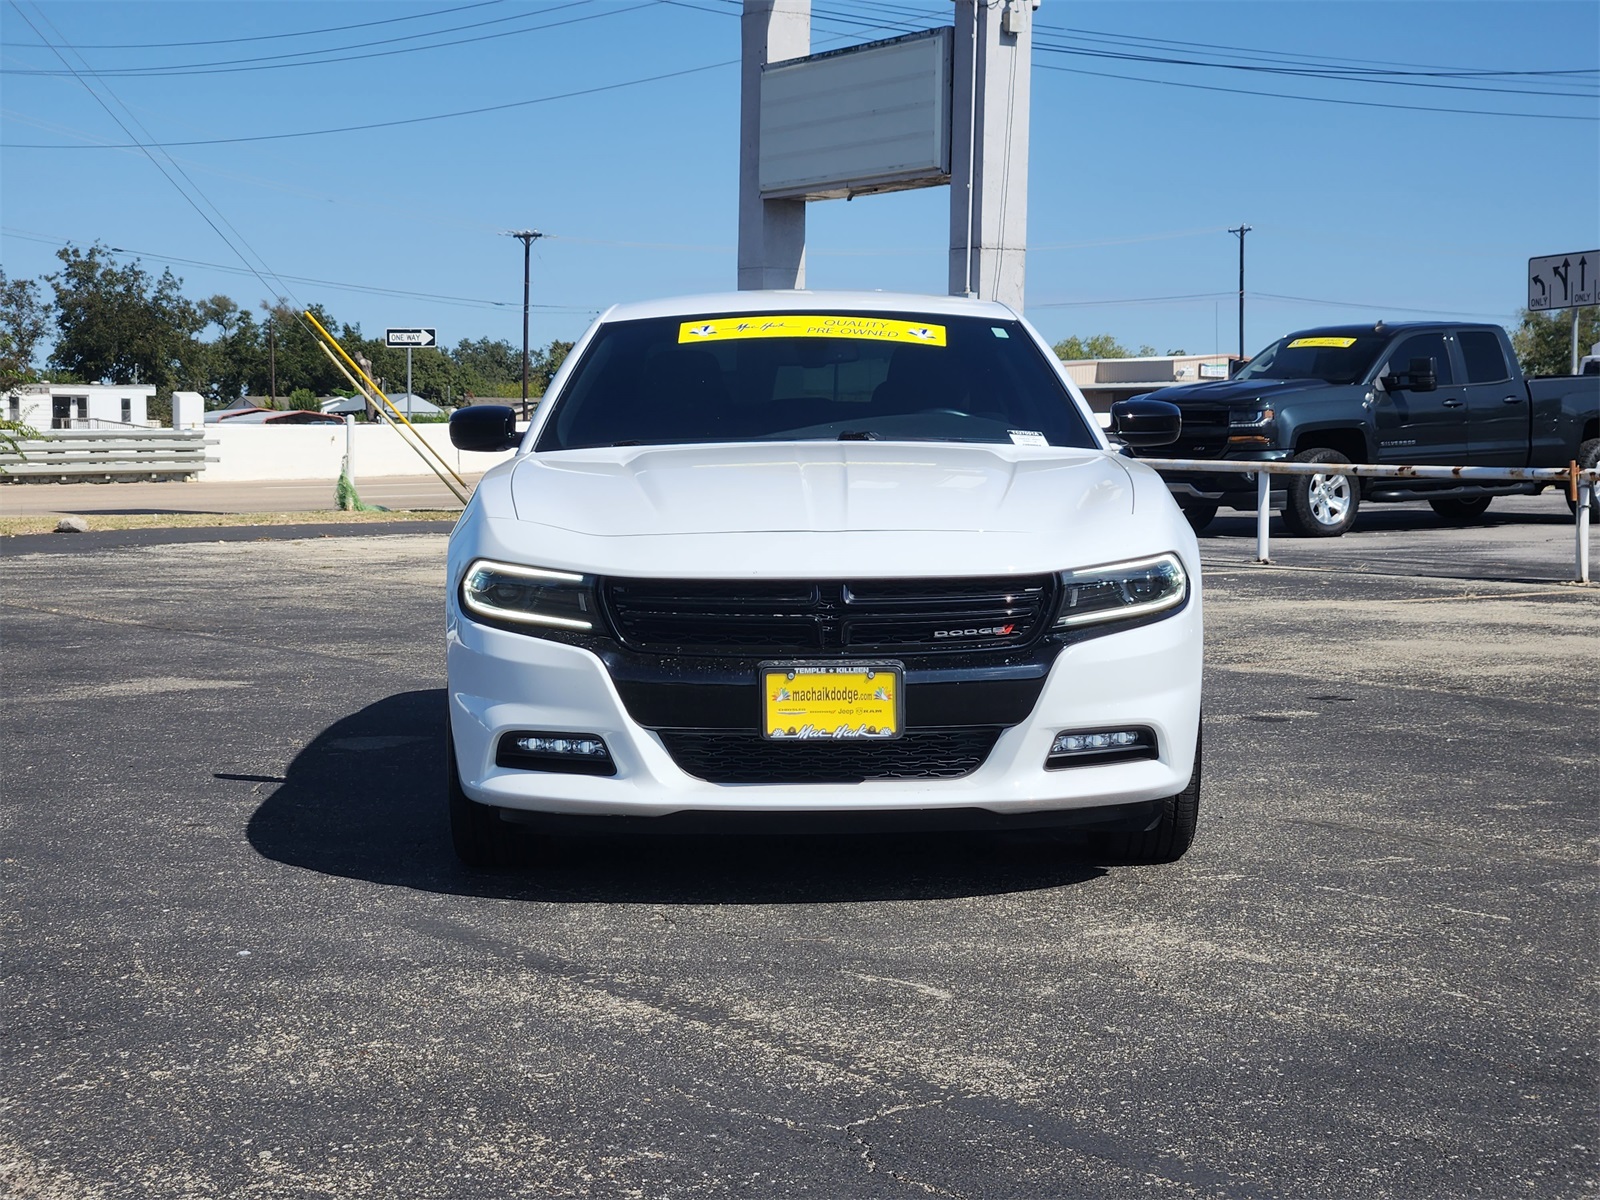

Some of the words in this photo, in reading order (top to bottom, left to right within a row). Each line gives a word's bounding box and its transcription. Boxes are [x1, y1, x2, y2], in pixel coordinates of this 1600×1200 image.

[1531, 296, 1548, 307] ONLY
[1574, 293, 1591, 303] ONLY
[824, 319, 889, 329] QUALITY
[806, 326, 899, 337] PRE-OWNED
[933, 626, 1005, 638] DODGE
[792, 687, 872, 704] machaikdodge.com
[798, 724, 829, 739] Mac
[832, 723, 868, 739] Haik
